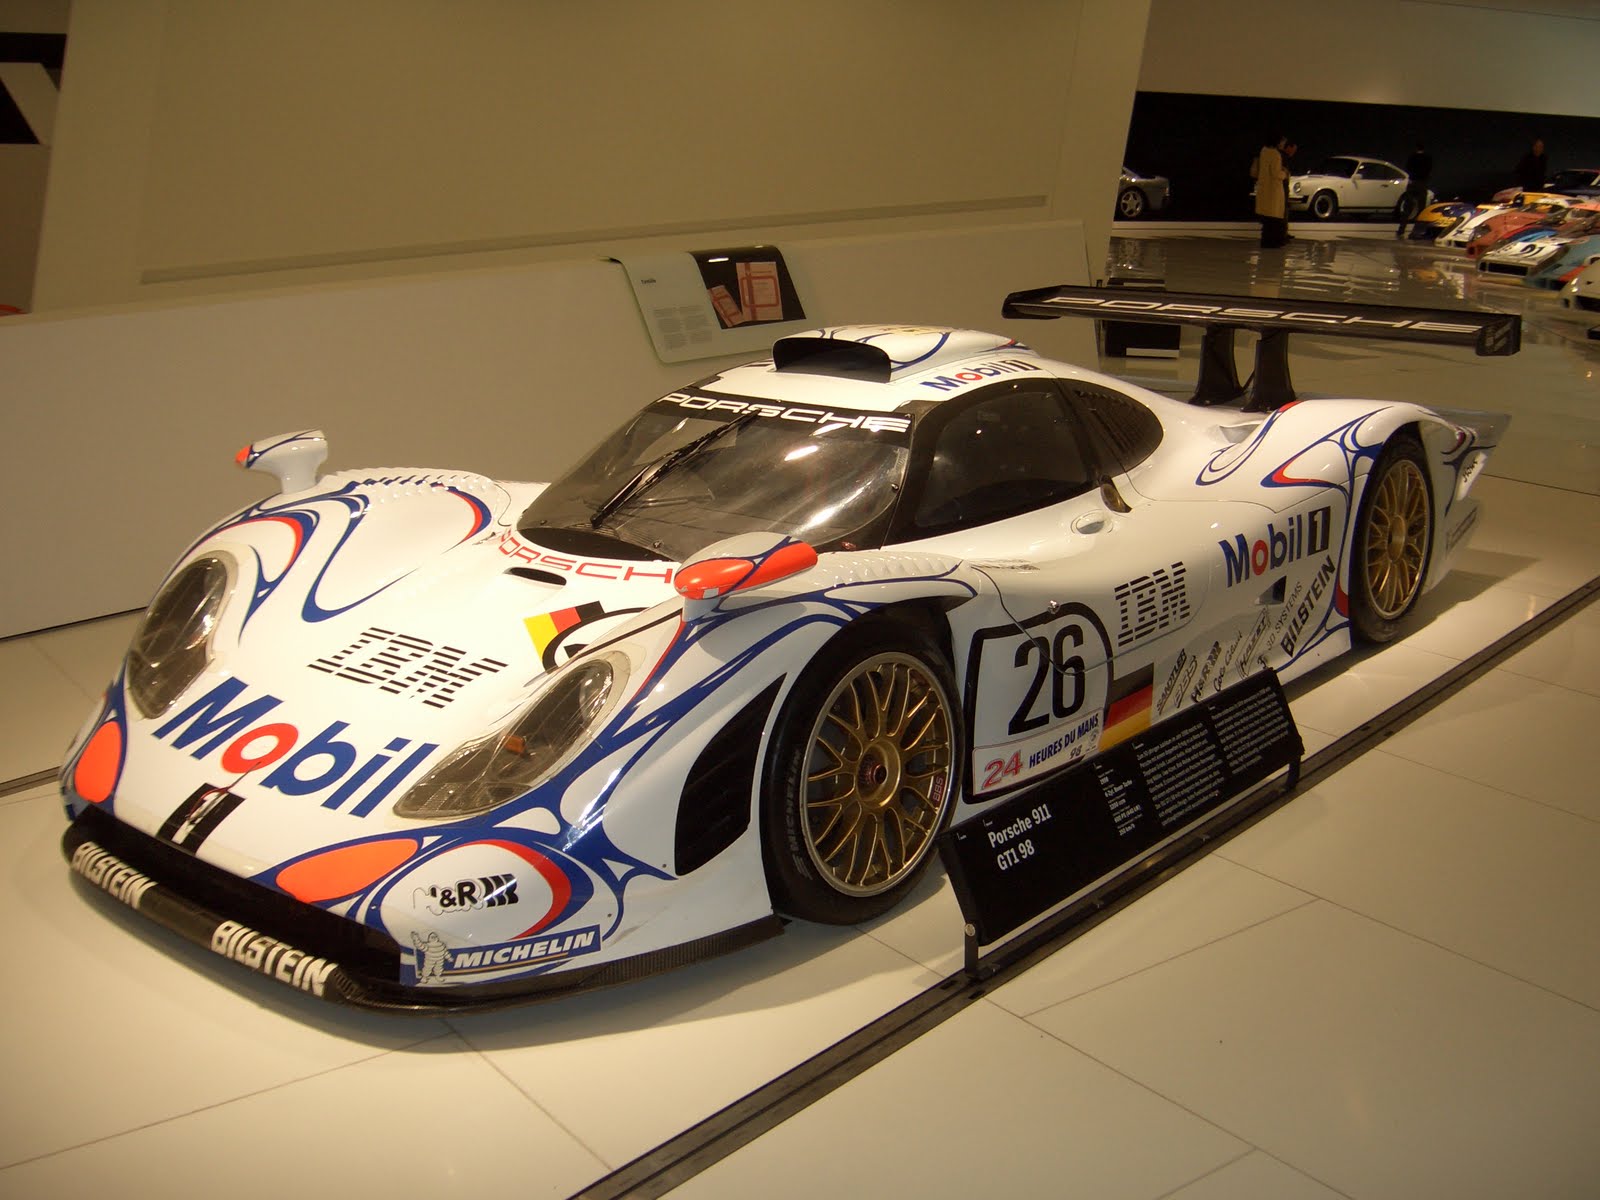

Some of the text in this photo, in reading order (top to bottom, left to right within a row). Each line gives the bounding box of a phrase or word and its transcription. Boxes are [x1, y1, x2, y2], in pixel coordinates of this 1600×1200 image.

[1042, 296, 1484, 334] PORSCHE
[920, 361, 1019, 392] Mobil
[657, 392, 911, 433] PORSCHE
[498, 530, 673, 584] PORSCH
[1218, 507, 1327, 589] Mobil 1
[1114, 560, 1191, 648] IBM
[1281, 554, 1336, 658] BILSTEIN
[306, 627, 510, 709] IBM
[1008, 624, 1086, 736] 26
[151, 676, 440, 819] Mobil
[981, 748, 1023, 790] 24
[1029, 738, 1063, 769] HEURES
[1064, 731, 1076, 748] DU
[1077, 713, 1099, 739] MANS
[932, 776, 944, 802] BBS
[988, 803, 1052, 848] Porsche 911
[997, 839, 1035, 871] GT1 98
[71, 841, 159, 910] BILSTEIN
[211, 920, 339, 997] BILSTEIN
[453, 930, 596, 969] MICHELIN
